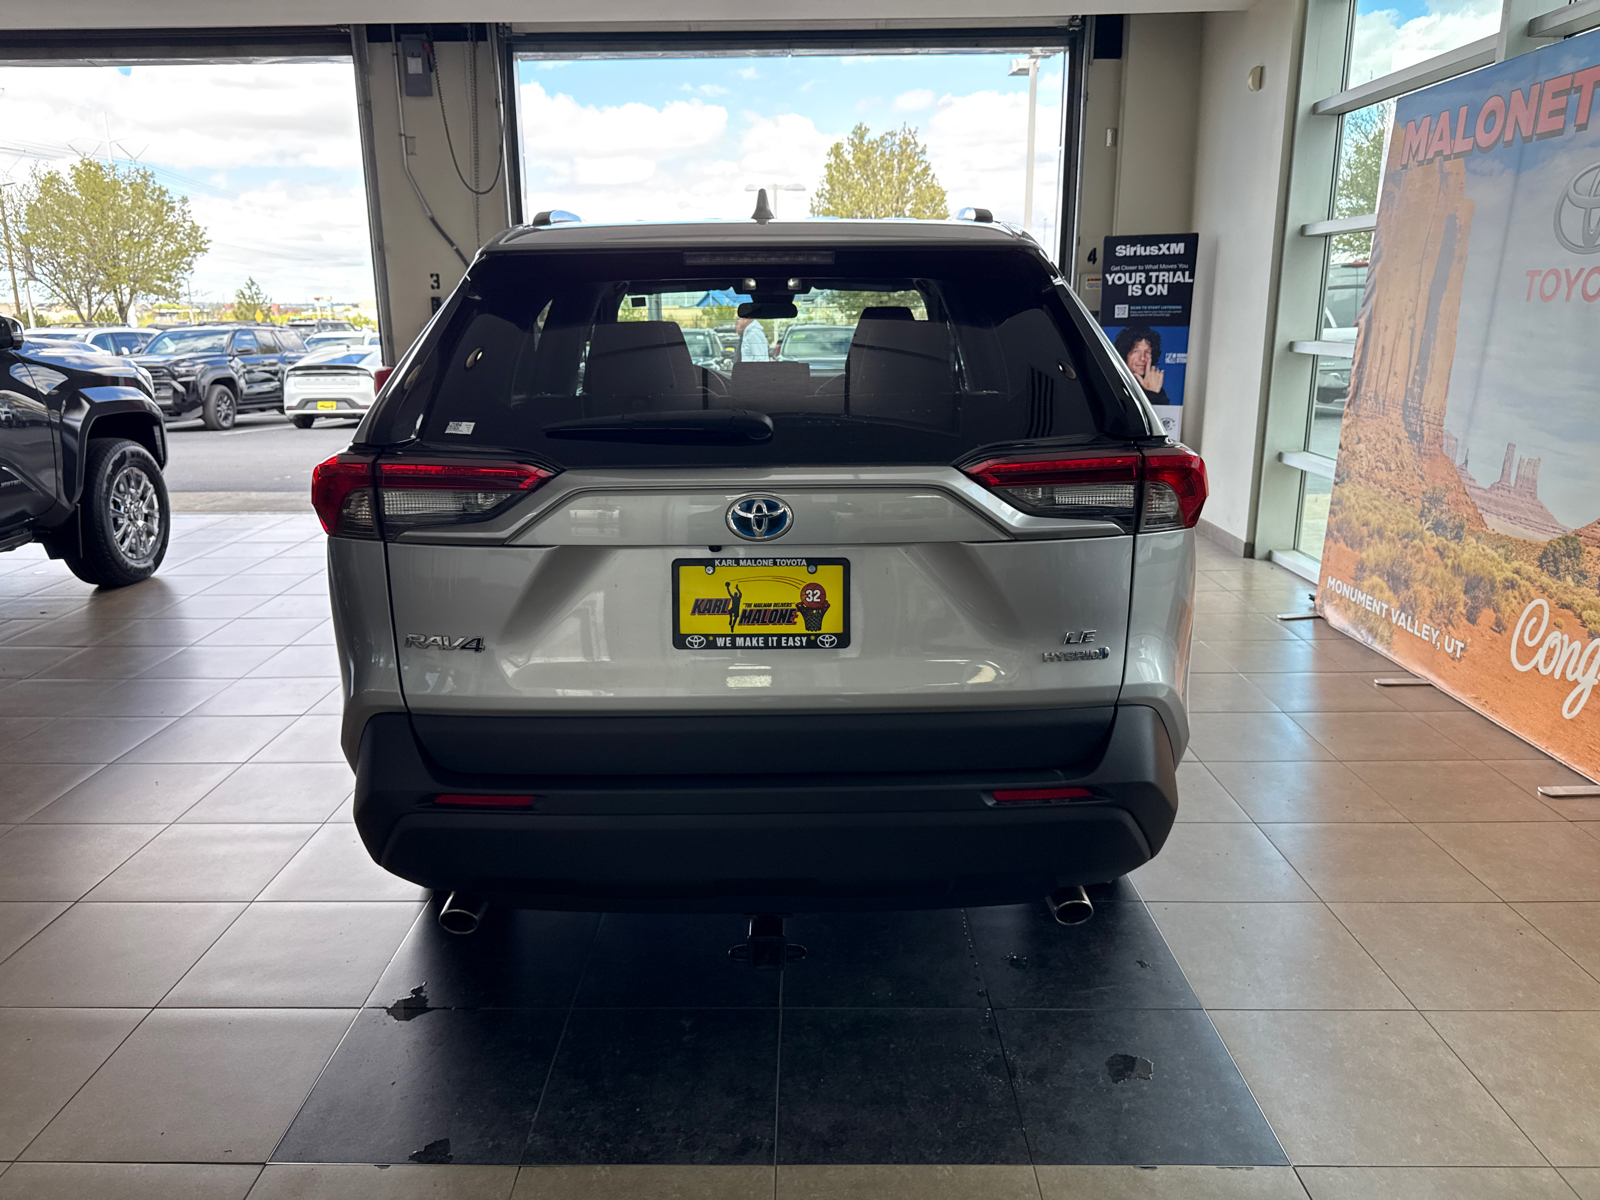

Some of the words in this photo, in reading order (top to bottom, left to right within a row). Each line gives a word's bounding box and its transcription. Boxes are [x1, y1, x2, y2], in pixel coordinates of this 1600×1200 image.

[1087, 247, 1097, 265] 4
[1115, 242, 1185, 257] SiriusXM
[430, 273, 440, 290] 3
[1105, 272, 1146, 285] YOUR
[1149, 270, 1194, 284] TRIAL
[1127, 284, 1142, 297] IS
[1145, 283, 1169, 296] ON
[714, 559, 738, 567] KARL
[739, 559, 774, 567] MALONE
[775, 558, 807, 566] TOYOTA
[805, 589, 821, 602] 32
[690, 598, 732, 616] KARL
[737, 608, 799, 626] MALONE
[1326, 575, 1389, 619] MONUMENT
[1391, 607, 1441, 650] VALLEY,
[1444, 634, 1465, 659] UT
[404, 633, 486, 653] RAV4
[716, 637, 732, 647] WE
[735, 637, 765, 647] MAKE
[768, 637, 777, 647] IT
[781, 636, 808, 647] EASY
[1062, 629, 1097, 645] LE
[1042, 649, 1101, 662] HYBRID
